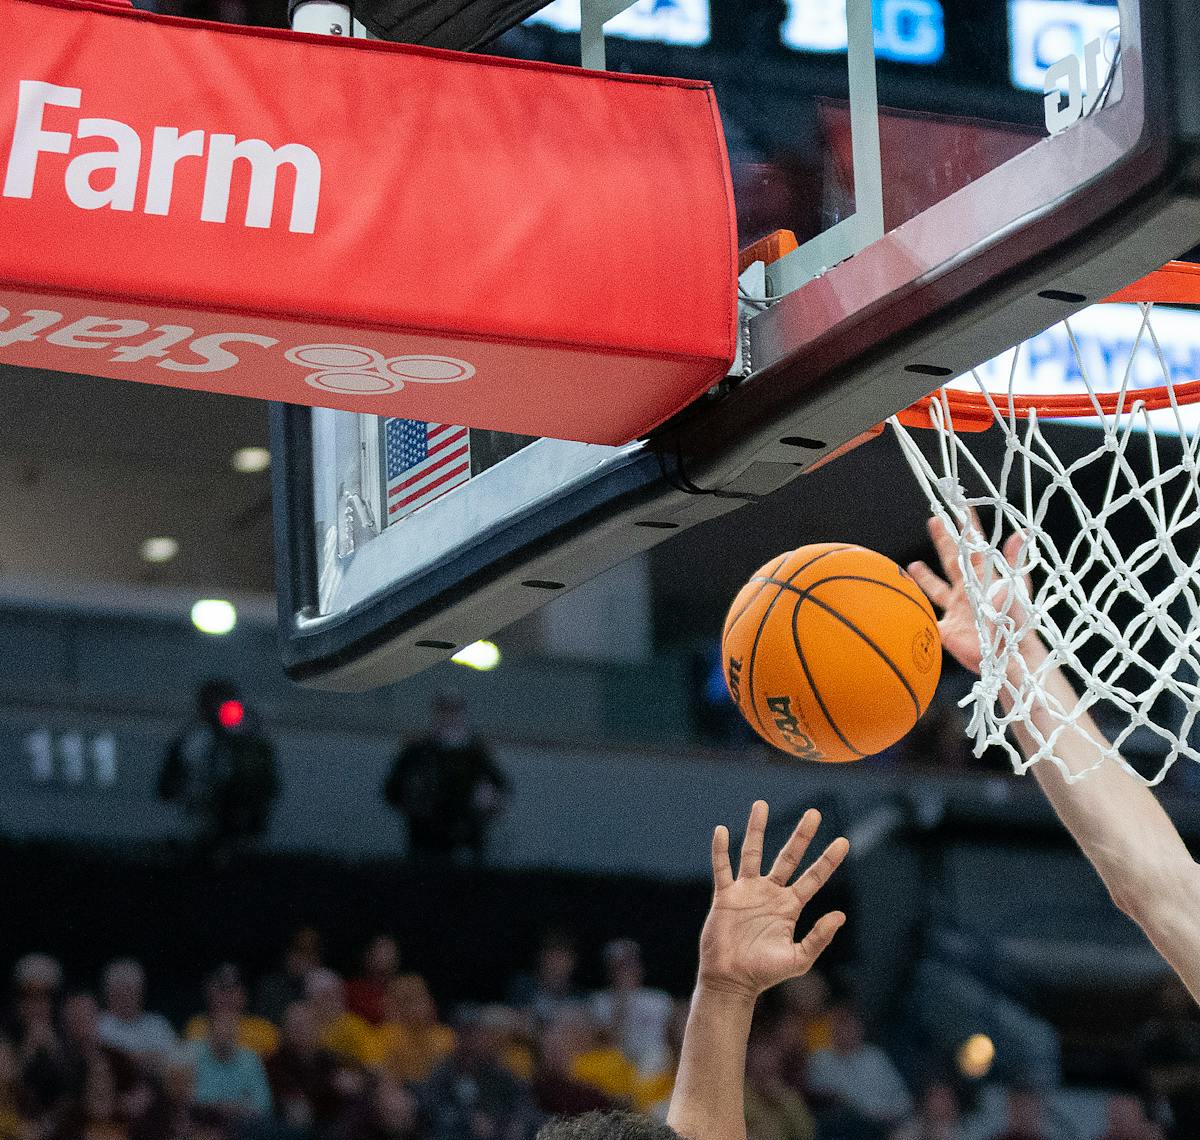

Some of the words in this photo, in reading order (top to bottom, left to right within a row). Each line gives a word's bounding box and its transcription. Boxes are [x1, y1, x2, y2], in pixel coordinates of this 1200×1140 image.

[2, 79, 322, 235] Farm
[0, 306, 280, 373] Stat
[29, 730, 117, 785] 111
